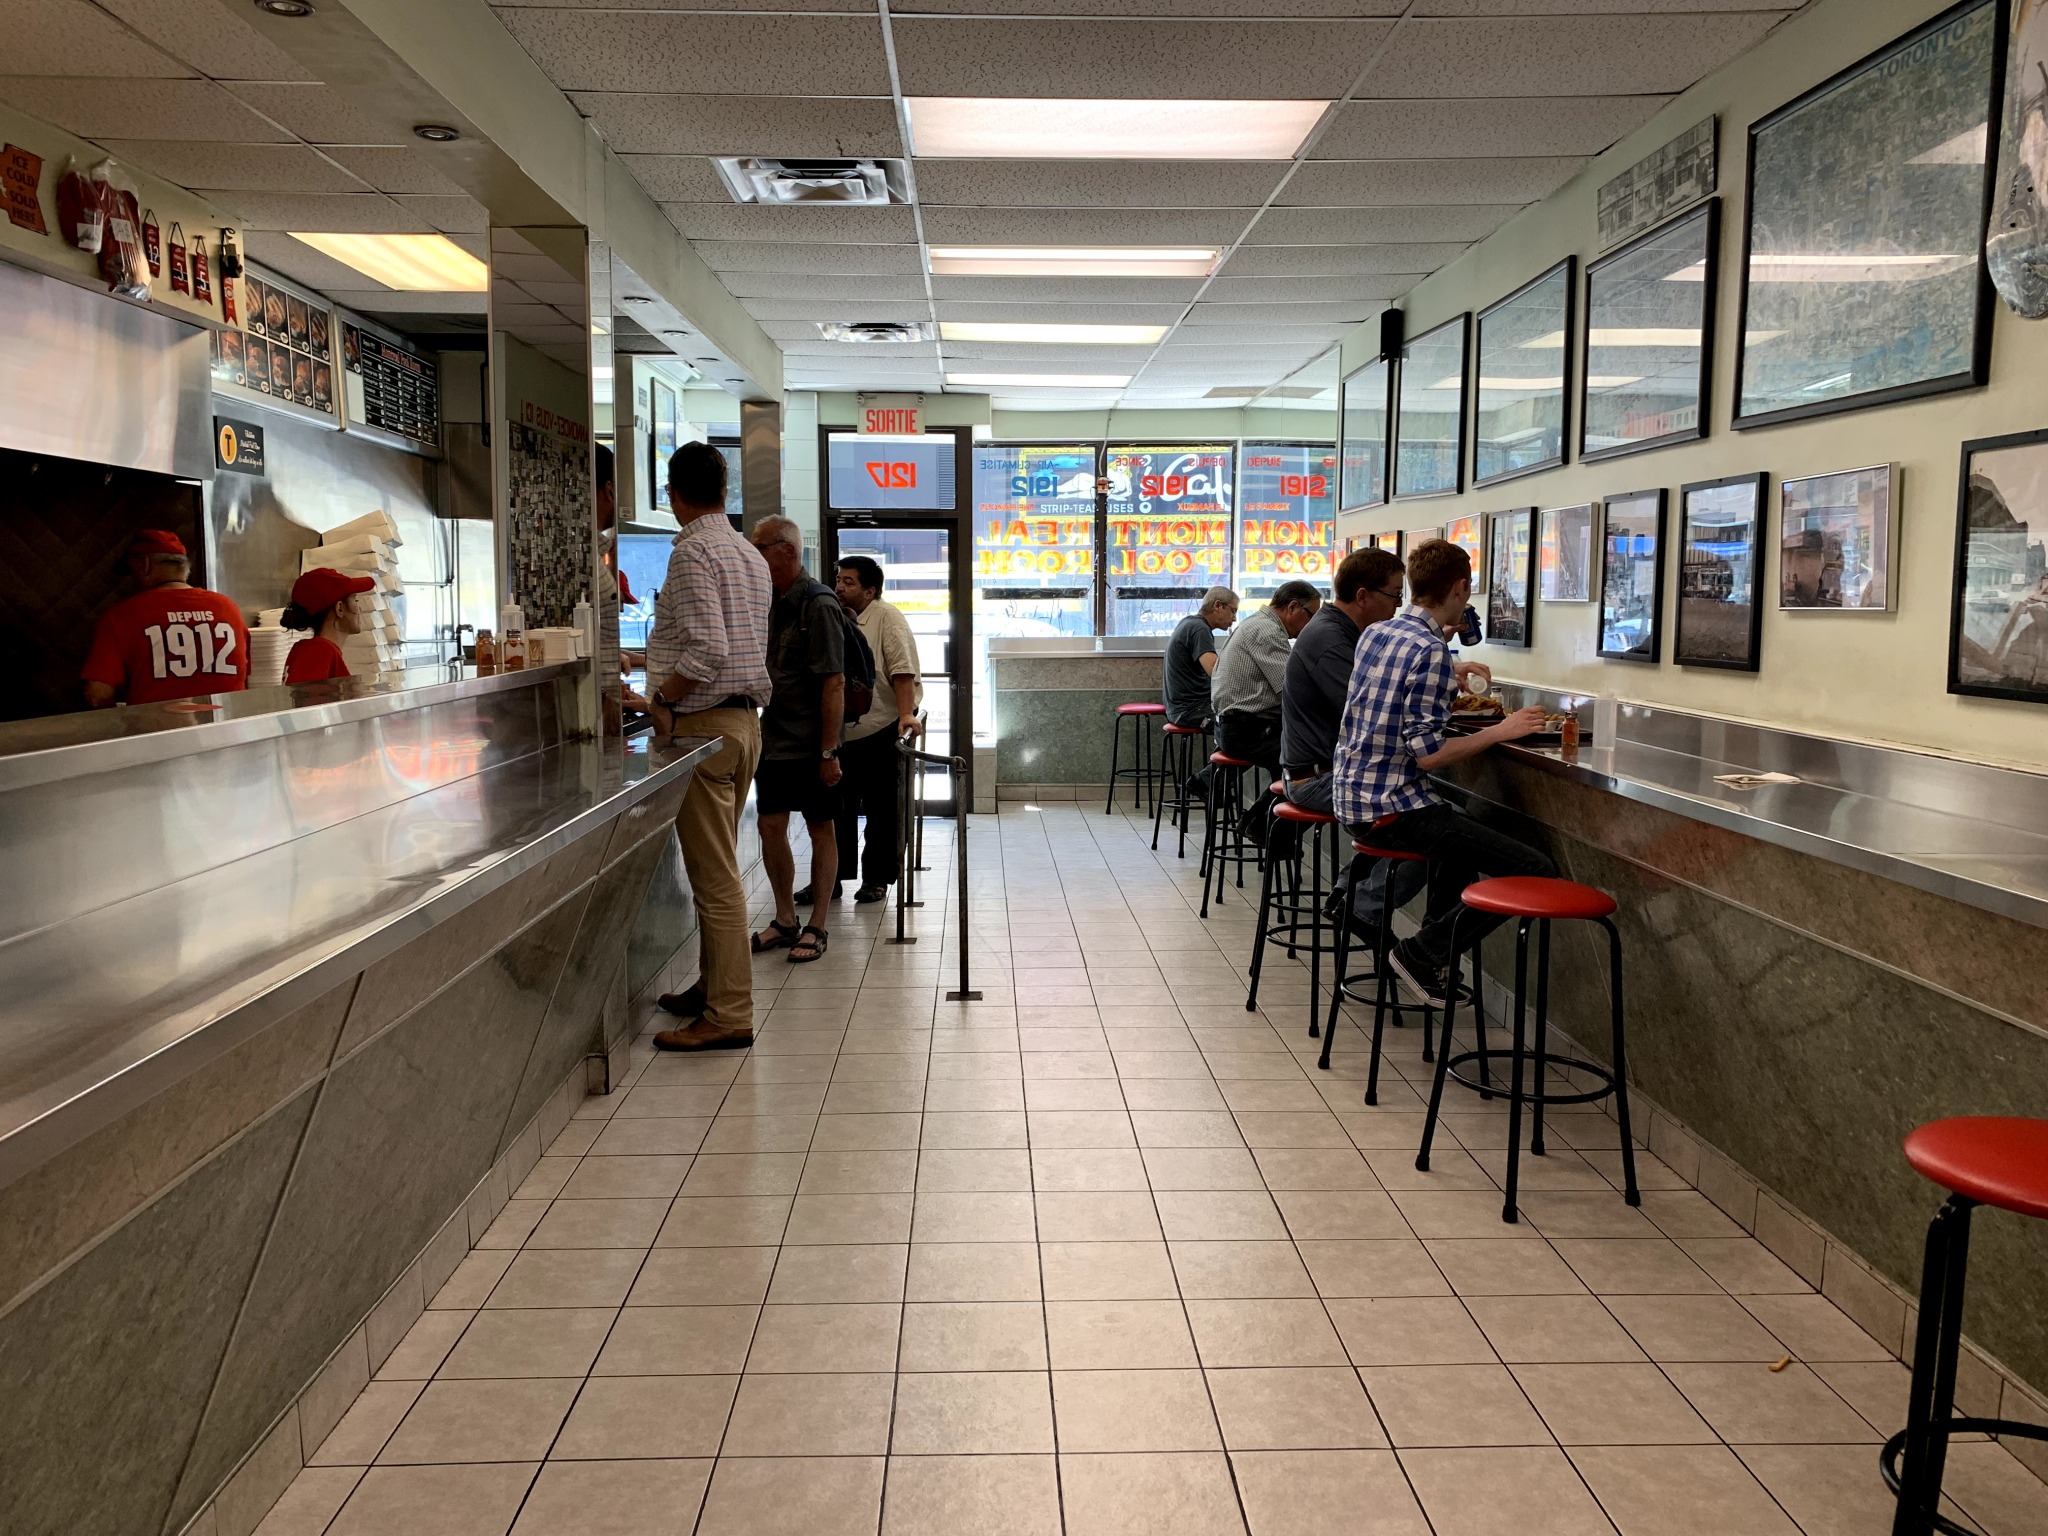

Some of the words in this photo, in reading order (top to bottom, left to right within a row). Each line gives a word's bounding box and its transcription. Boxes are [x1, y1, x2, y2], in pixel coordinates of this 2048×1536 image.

[1877, 19, 1967, 82] TORONTO
[12, 153, 29, 170] ICE
[7, 166, 36, 188] COLD
[10, 190, 36, 210] SOLD
[12, 206, 36, 225] HERE
[149, 243, 160, 266] 12
[198, 271, 207, 291] 5
[866, 409, 918, 433] SORTIE
[1247, 457, 1281, 467] DEPUIS
[1280, 475, 1327, 497] 1912
[167, 611, 214, 622] DEPUIS
[144, 622, 238, 679] 1912
